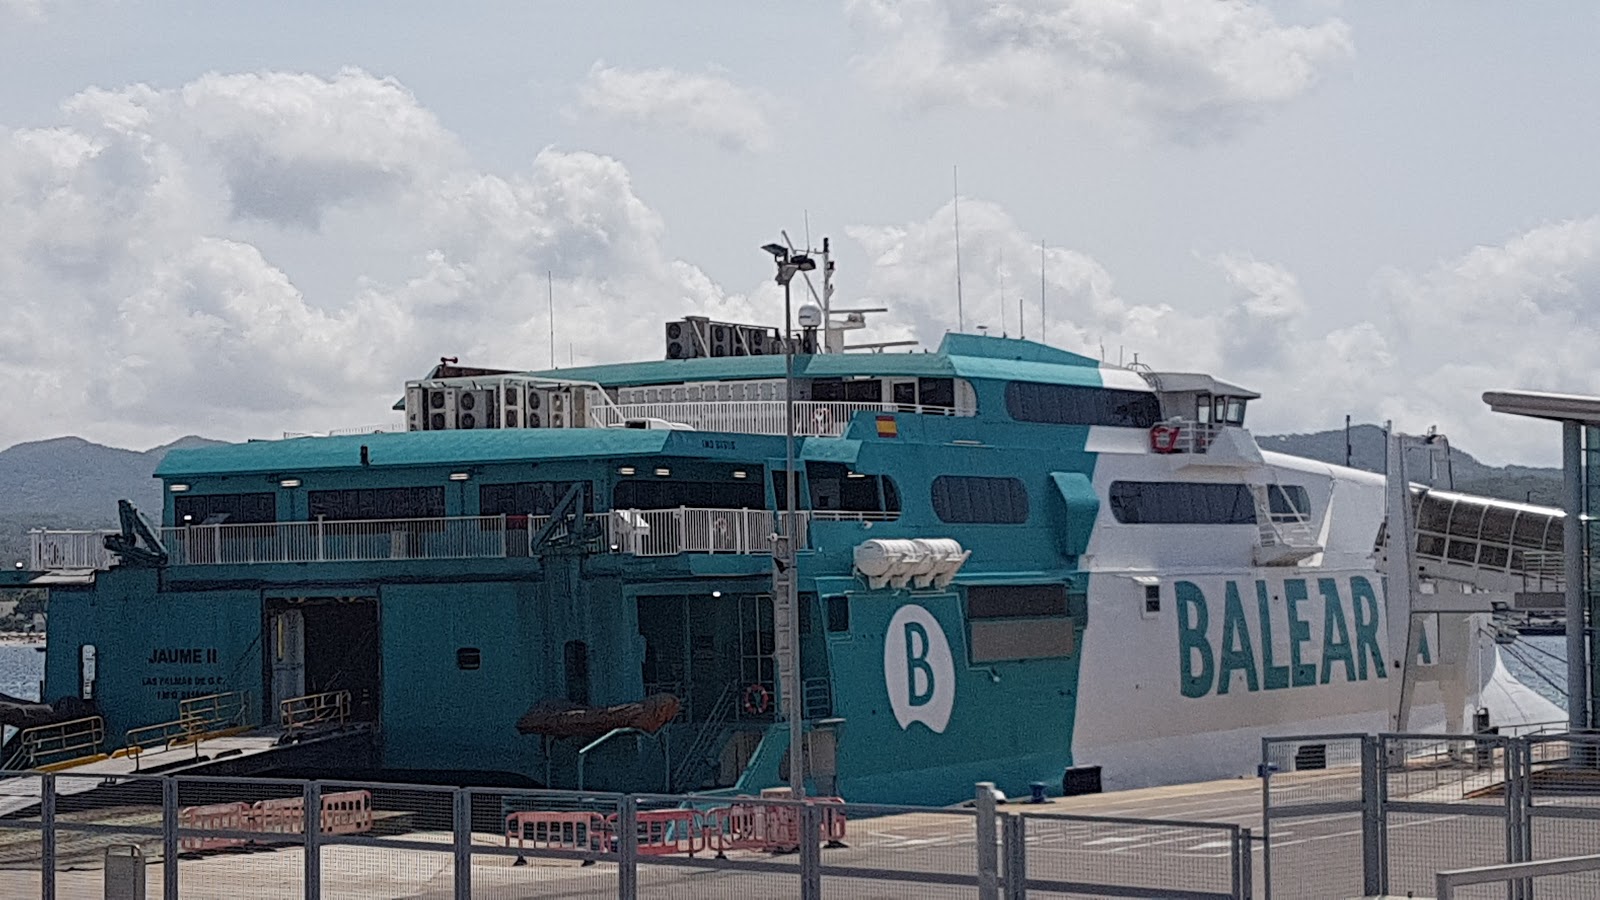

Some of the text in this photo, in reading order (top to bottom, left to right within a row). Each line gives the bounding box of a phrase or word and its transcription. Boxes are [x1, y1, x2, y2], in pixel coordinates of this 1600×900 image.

[148, 648, 217, 664] JAUME II
[904, 621, 935, 707] B
[142, 677, 158, 686] LAS
[160, 676, 193, 686] PALMAS
[195, 676, 206, 686] DE
